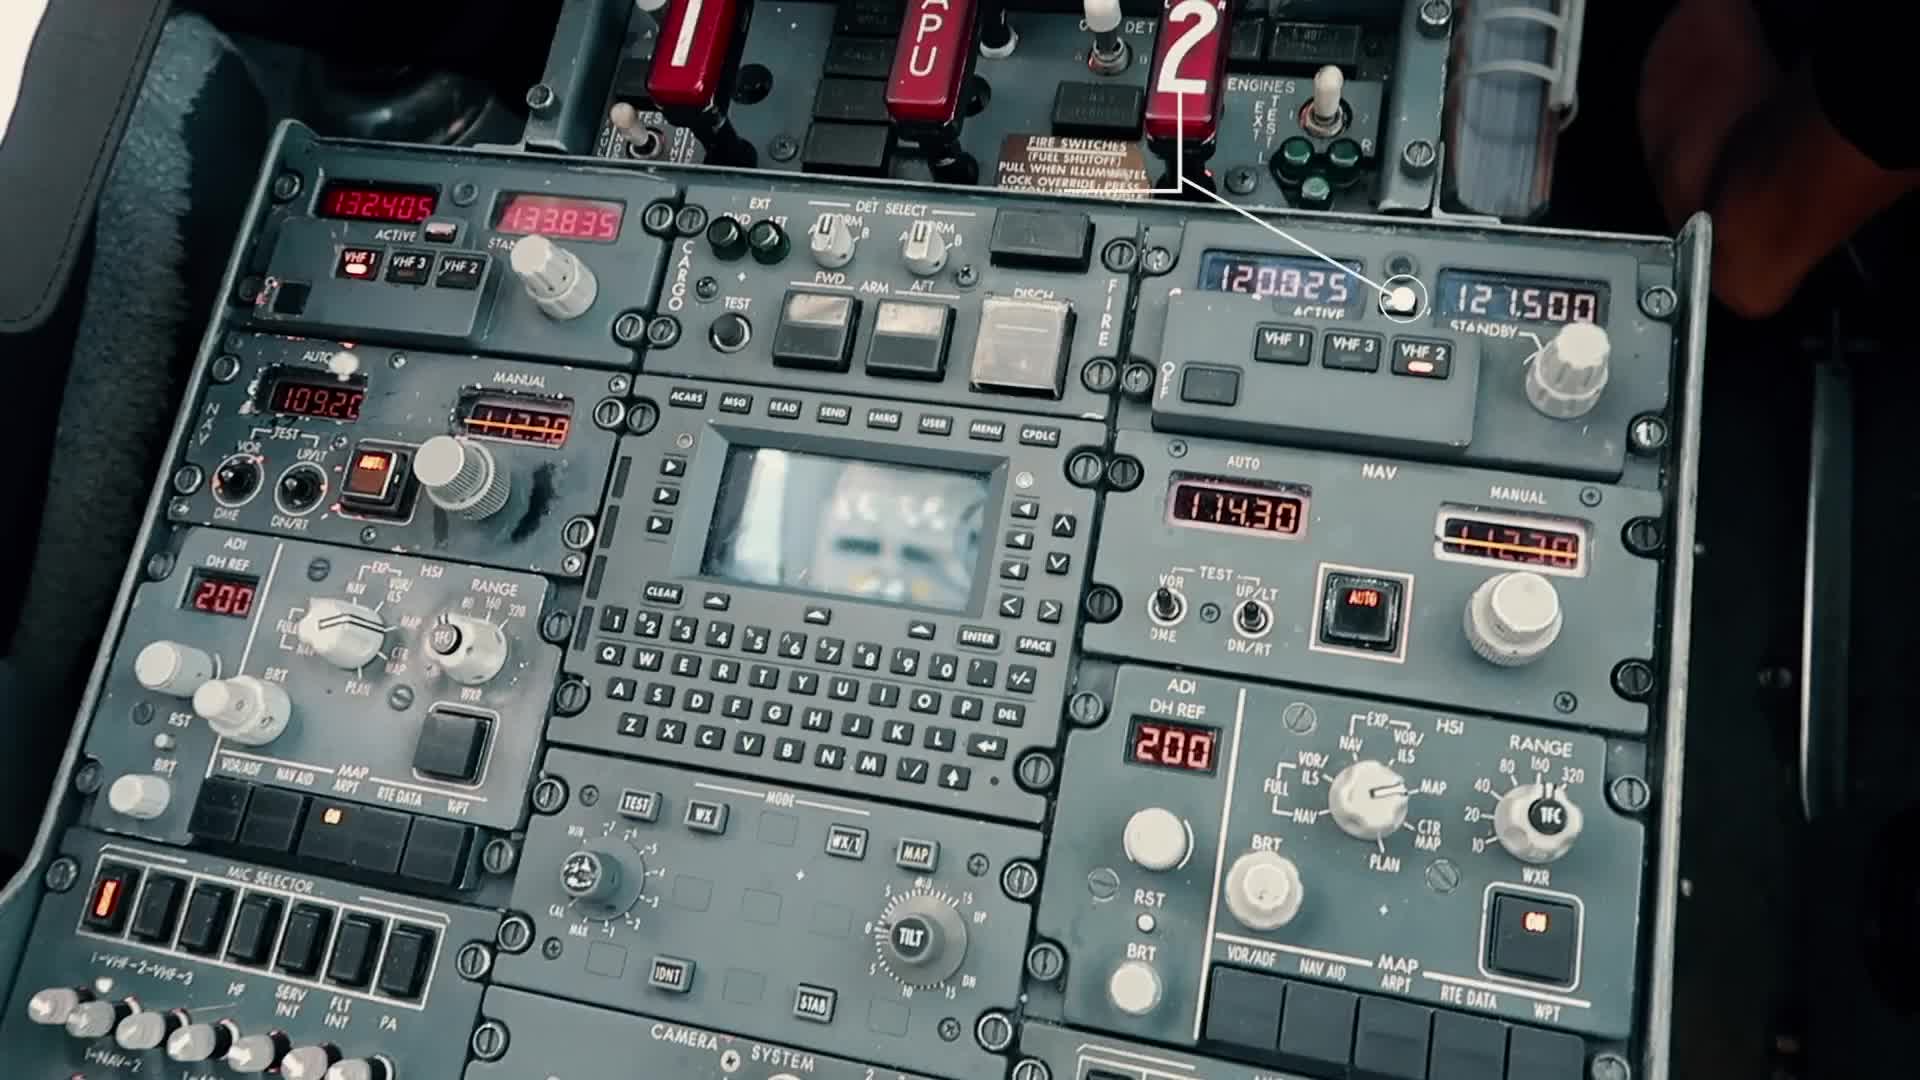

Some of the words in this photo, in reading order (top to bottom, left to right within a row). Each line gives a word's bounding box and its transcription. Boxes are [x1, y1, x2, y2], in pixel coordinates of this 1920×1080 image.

[1125, 20, 1156, 34] DET
[1157, 0, 1218, 94] 2
[1227, 77, 1296, 93] ENGINES
[1029, 136, 1056, 147] FIRE
[1061, 138, 1128, 152] SWITCHES
[1361, 139, 1372, 152] R
[1028, 151, 1058, 162] (FUEL
[1063, 154, 1121, 167] SHUTOFF)
[999, 161, 1025, 172] PULL
[1030, 163, 1066, 175] WHEN
[1002, 175, 1032, 185] LOCK
[750, 198, 772, 211] EXT
[856, 200, 879, 214] DET
[885, 203, 928, 217] SELECT
[375, 229, 417, 242] ACTIVE
[344, 252, 366, 263] VHF
[369, 253, 376, 264] 1
[393, 256, 415, 268] VHF
[417, 257, 426, 269] 3
[445, 260, 467, 271] VHF
[470, 263, 479, 274] 2
[668, 241, 695, 311] CARGO
[815, 271, 845, 285] FWD
[859, 280, 889, 294] ARM
[910, 281, 935, 292] AFT
[724, 296, 751, 310] TEST
[1458, 284, 1596, 322] 121.500
[1098, 279, 1119, 347] FIRE
[1451, 320, 1520, 339] STANDBY
[1265, 331, 1293, 345] VHF
[1299, 334, 1305, 347] 1
[1333, 337, 1361, 351] VHF
[1365, 339, 1375, 352] 3
[1401, 343, 1431, 359] VHF
[1436, 347, 1446, 361] 2
[493, 371, 546, 388] MANUAL
[671, 391, 703, 403] ACARS
[770, 402, 798, 413] READ
[820, 407, 847, 418] SEND
[922, 418, 948, 429] USER
[972, 423, 1002, 435] MENU
[271, 426, 300, 441] TEST
[1022, 429, 1056, 441] CPDLC
[238, 441, 262, 453] VOR
[1227, 456, 1260, 471] AUTO
[1362, 463, 1398, 480] NAV
[1489, 485, 1547, 505] MANUAL
[212, 507, 240, 522] DME
[270, 515, 309, 531] DN/RT
[224, 537, 248, 551] ADI
[206, 554, 226, 568] DH
[227, 558, 250, 572] REF
[421, 565, 444, 578] HSI
[1200, 565, 1234, 582] TEST
[471, 578, 519, 596] RANGE
[1159, 573, 1184, 588] VOR
[195, 582, 253, 615] 200
[647, 586, 679, 599] CLEAR
[1236, 583, 1279, 601] UP/LT
[1348, 590, 1378, 607] AUTO
[962, 630, 995, 644] ENTER
[602, 646, 615, 661] Q
[1020, 638, 1053, 653] SPACE
[1227, 639, 1273, 656] DN/RT
[639, 652, 655, 666] W
[718, 664, 729, 679] R
[759, 669, 768, 684] T
[612, 682, 624, 697] A
[798, 676, 808, 690] Y
[837, 681, 849, 696] U
[1167, 679, 1196, 695] ADI
[691, 694, 703, 708] D
[917, 694, 932, 708] O
[768, 706, 782, 720] G
[998, 708, 1018, 721] DEL
[1150, 699, 1174, 716] DH
[1177, 703, 1206, 720] REF
[168, 712, 192, 728] RST
[624, 718, 637, 732] Z
[808, 712, 822, 727] H
[1436, 719, 1465, 735] HSI
[663, 724, 676, 739] X
[702, 730, 713, 745] C
[891, 725, 904, 740] K
[1393, 729, 1424, 747] VOR/
[742, 736, 755, 751] V
[1136, 727, 1212, 769] 200
[1338, 735, 1364, 752] NAV
[1510, 734, 1573, 758] RANGE
[821, 749, 836, 764] N
[861, 757, 877, 772] M
[1298, 751, 1329, 769] VOR/
[1398, 749, 1416, 764] ILS
[1531, 755, 1550, 773] 160
[337, 764, 369, 781] MAP
[1500, 758, 1516, 774] 80
[1302, 770, 1320, 786] ILS
[1561, 766, 1585, 784] 320
[333, 779, 360, 795] ARPT
[1264, 778, 1289, 797] FULL
[1420, 779, 1447, 796] MAP
[1474, 777, 1491, 793] 40
[376, 786, 397, 802] RTE
[398, 791, 423, 808] DATA
[625, 795, 649, 812] TEST
[766, 791, 795, 808] MODE
[695, 807, 713, 823] WX
[1292, 807, 1319, 825] NAV
[1464, 805, 1480, 822] 20
[1417, 819, 1441, 835] CTR
[1252, 834, 1283, 851] BRT
[1415, 836, 1441, 851] MAP
[1472, 837, 1485, 854] 10
[903, 845, 929, 864] MAP
[1369, 855, 1400, 873] PLAN
[226, 866, 251, 881] MIC
[255, 871, 314, 893] SELECTOR
[1522, 867, 1550, 886] WXR
[1134, 888, 1165, 906] RST
[974, 912, 987, 924] UP
[899, 927, 925, 947] TILT
[1127, 942, 1156, 961] BRT
[1227, 944, 1278, 968] VOR/ADF
[1300, 958, 1323, 977] NAV
[1326, 963, 1346, 981] AID
[1378, 953, 1418, 975] MAP
[655, 965, 681, 983] IDNT
[1381, 975, 1411, 994] ARPT
[275, 984, 309, 1002] SERV
[1440, 985, 1462, 1006] RTE
[1467, 990, 1497, 1010] DATA
[275, 1002, 300, 1019] INT
[329, 996, 352, 1013] FLT
[800, 995, 826, 1015] STAB
[1534, 1003, 1560, 1023] WPT
[324, 1013, 350, 1030] INT
[379, 1016, 397, 1031] PA
[651, 1023, 719, 1051] CAMERA
[751, 1044, 815, 1072] SYSTEM
